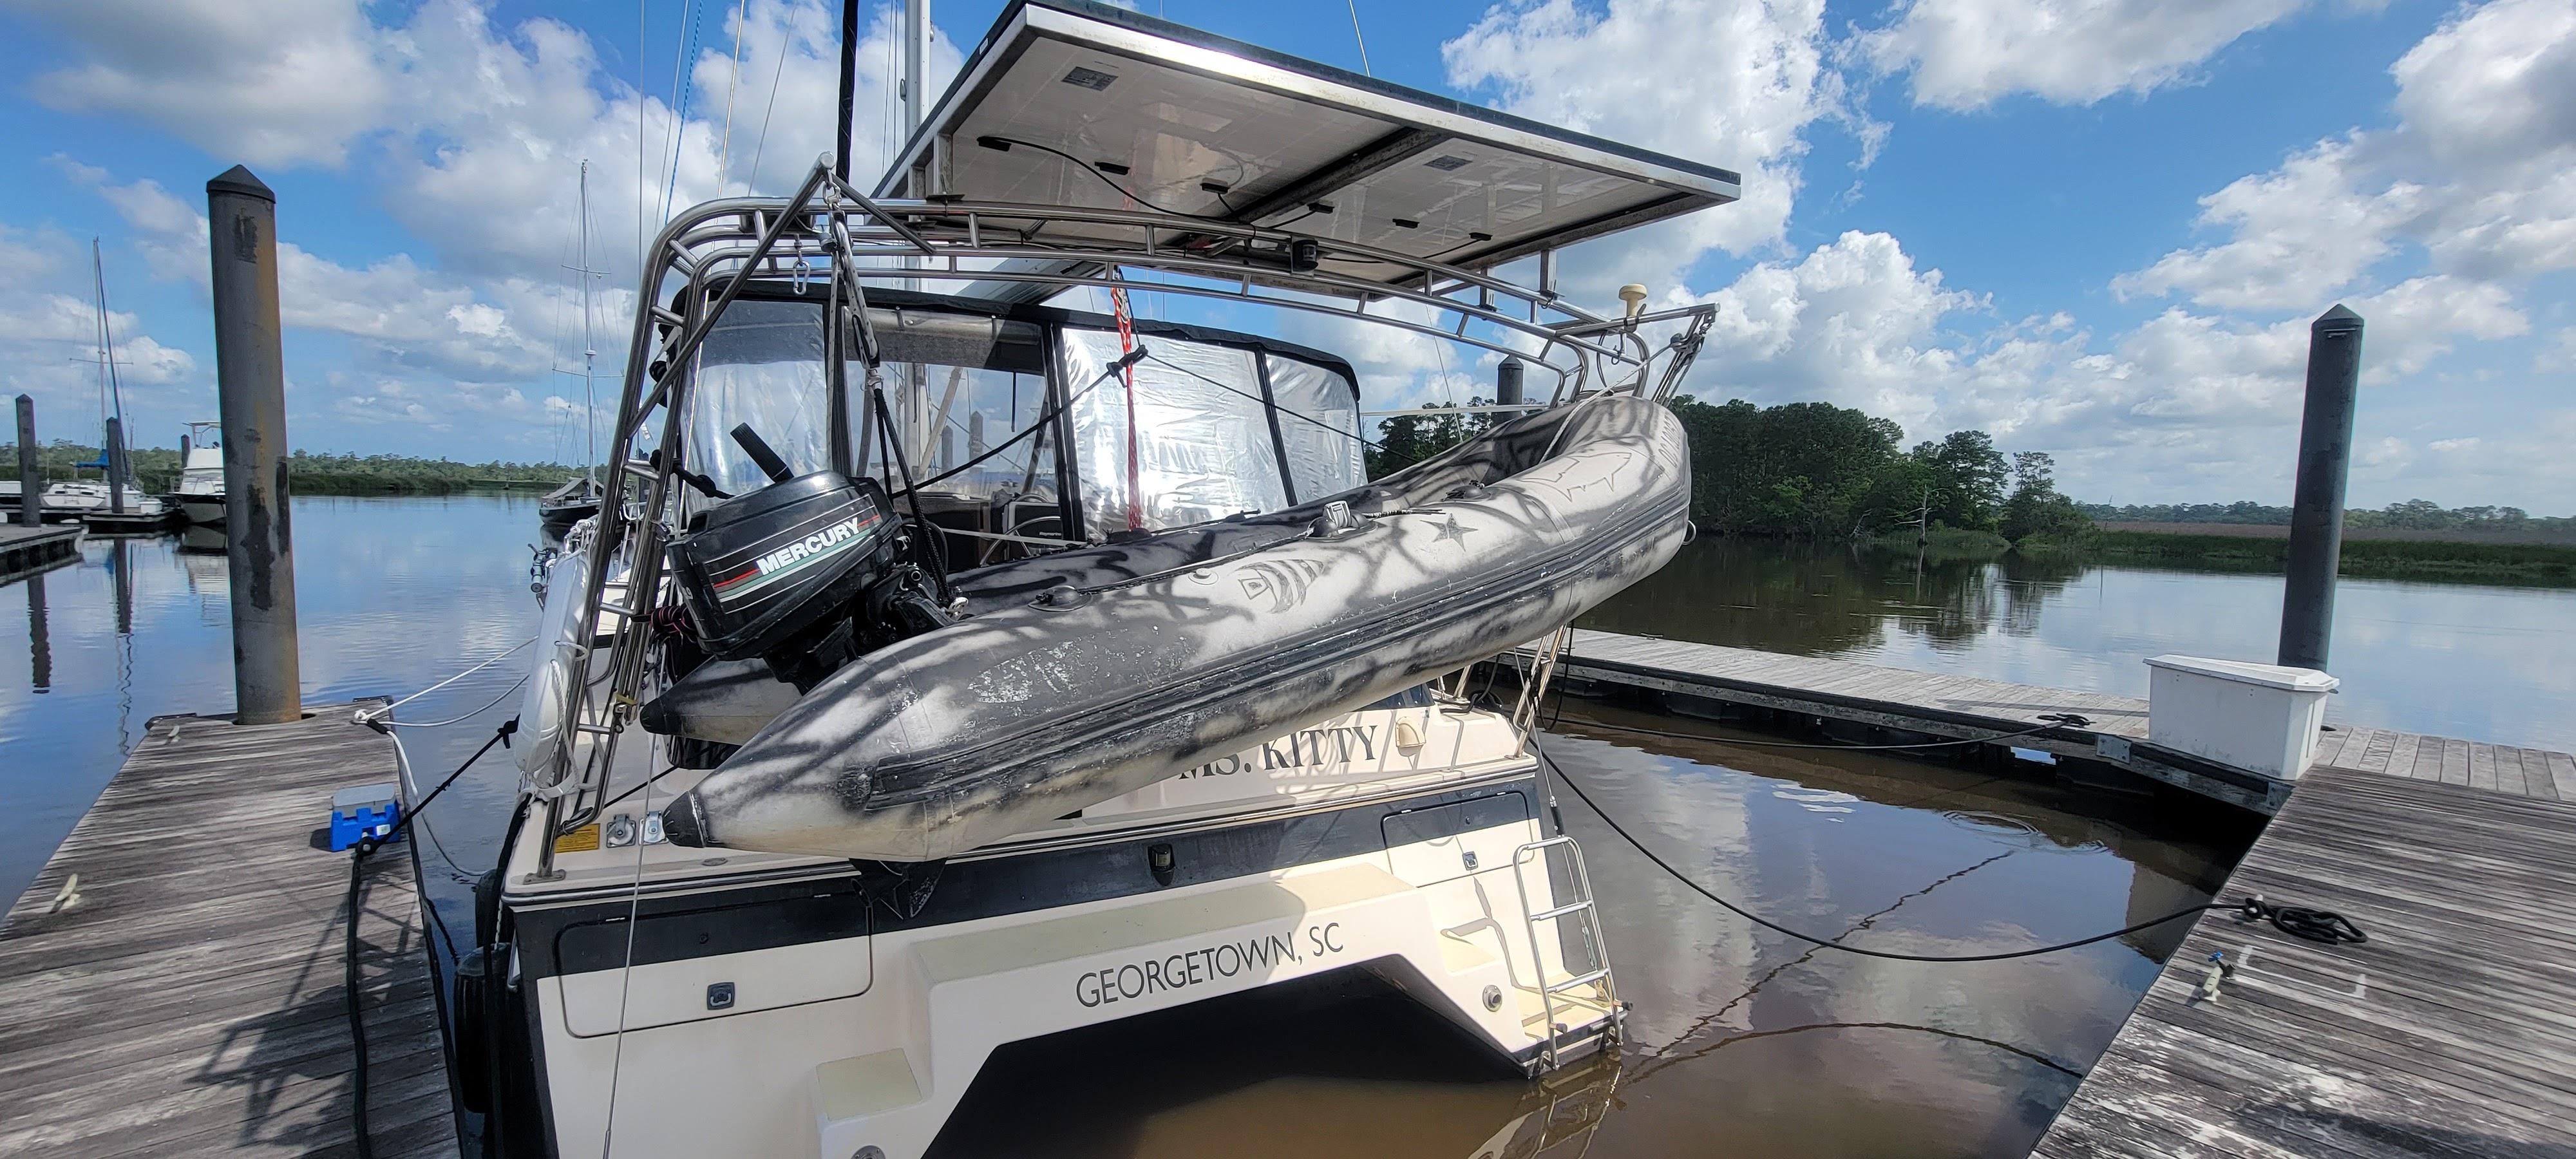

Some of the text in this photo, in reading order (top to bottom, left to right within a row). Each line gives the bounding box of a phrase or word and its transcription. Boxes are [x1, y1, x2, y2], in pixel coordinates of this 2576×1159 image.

[757, 517, 860, 576] MERCURY
[1263, 725, 1378, 771] KITTY
[1076, 922, 1343, 1008] GEORGETOWN, SC
